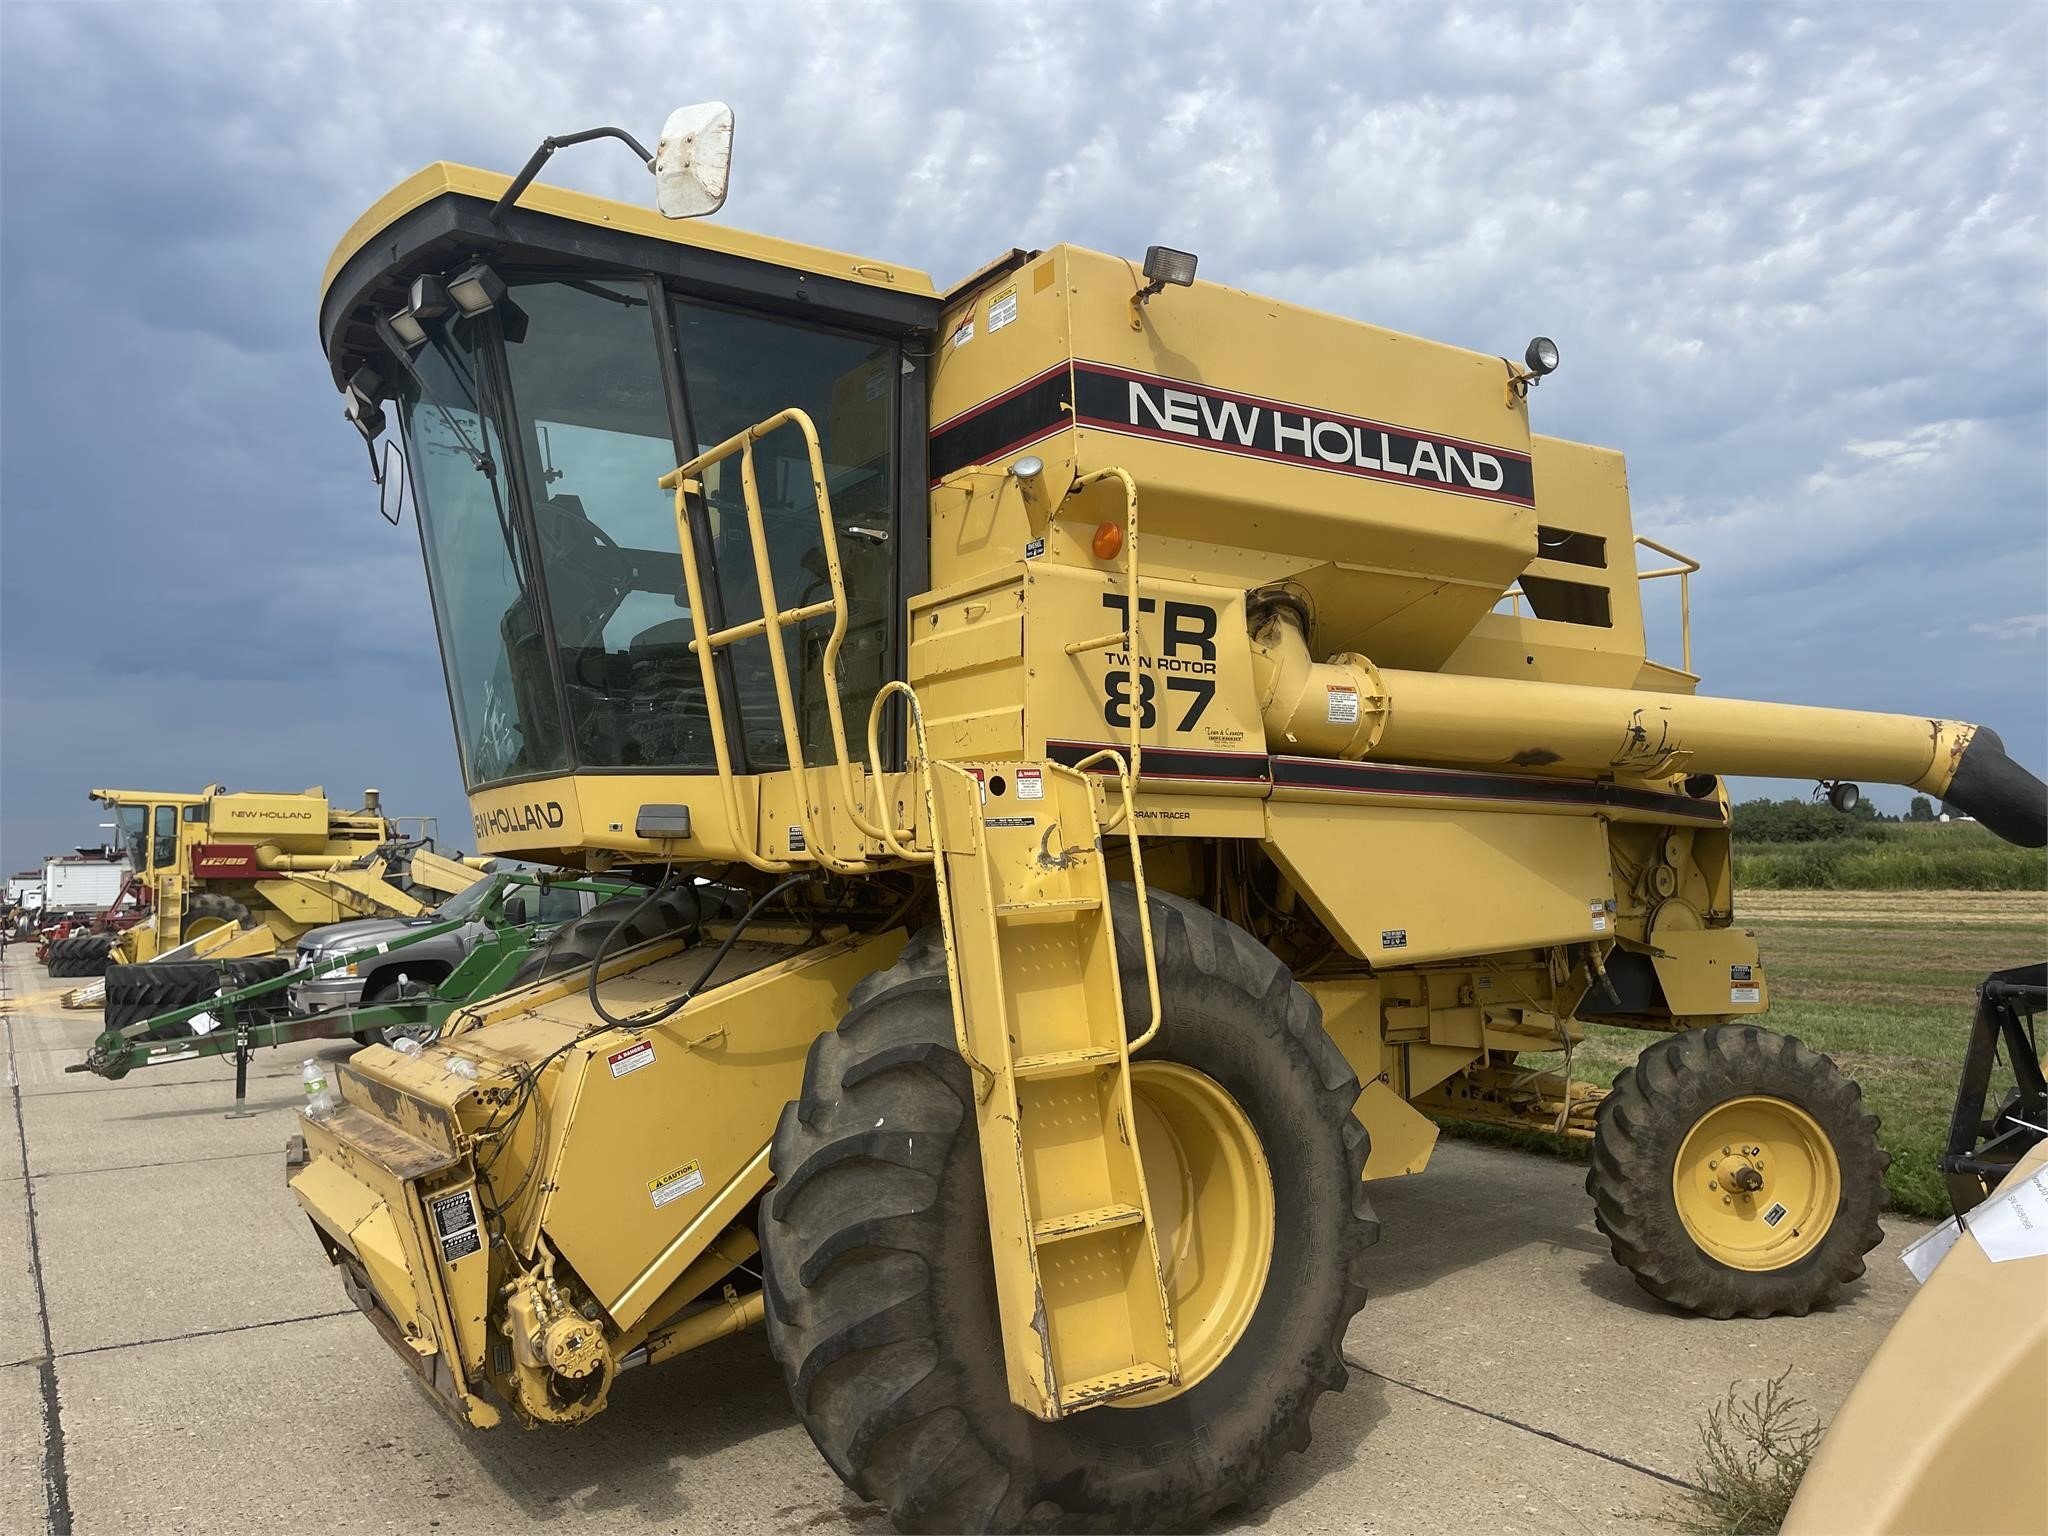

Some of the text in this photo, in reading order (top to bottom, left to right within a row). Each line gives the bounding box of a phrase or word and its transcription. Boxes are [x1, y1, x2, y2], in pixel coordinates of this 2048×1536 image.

[1128, 380, 1504, 491] NEW HOLLAND
[1102, 592, 1218, 661] TR
[1104, 652, 1217, 675] TWN ROTOR
[1104, 670, 1217, 733] 87
[231, 810, 312, 820] NEW HOLLAND
[474, 801, 564, 839] EW HOLLAND
[1134, 810, 1190, 820] RRAIN TRACER
[663, 1164, 693, 1183] CAUTION
[437, 1192, 467, 1207] ATTENTION
